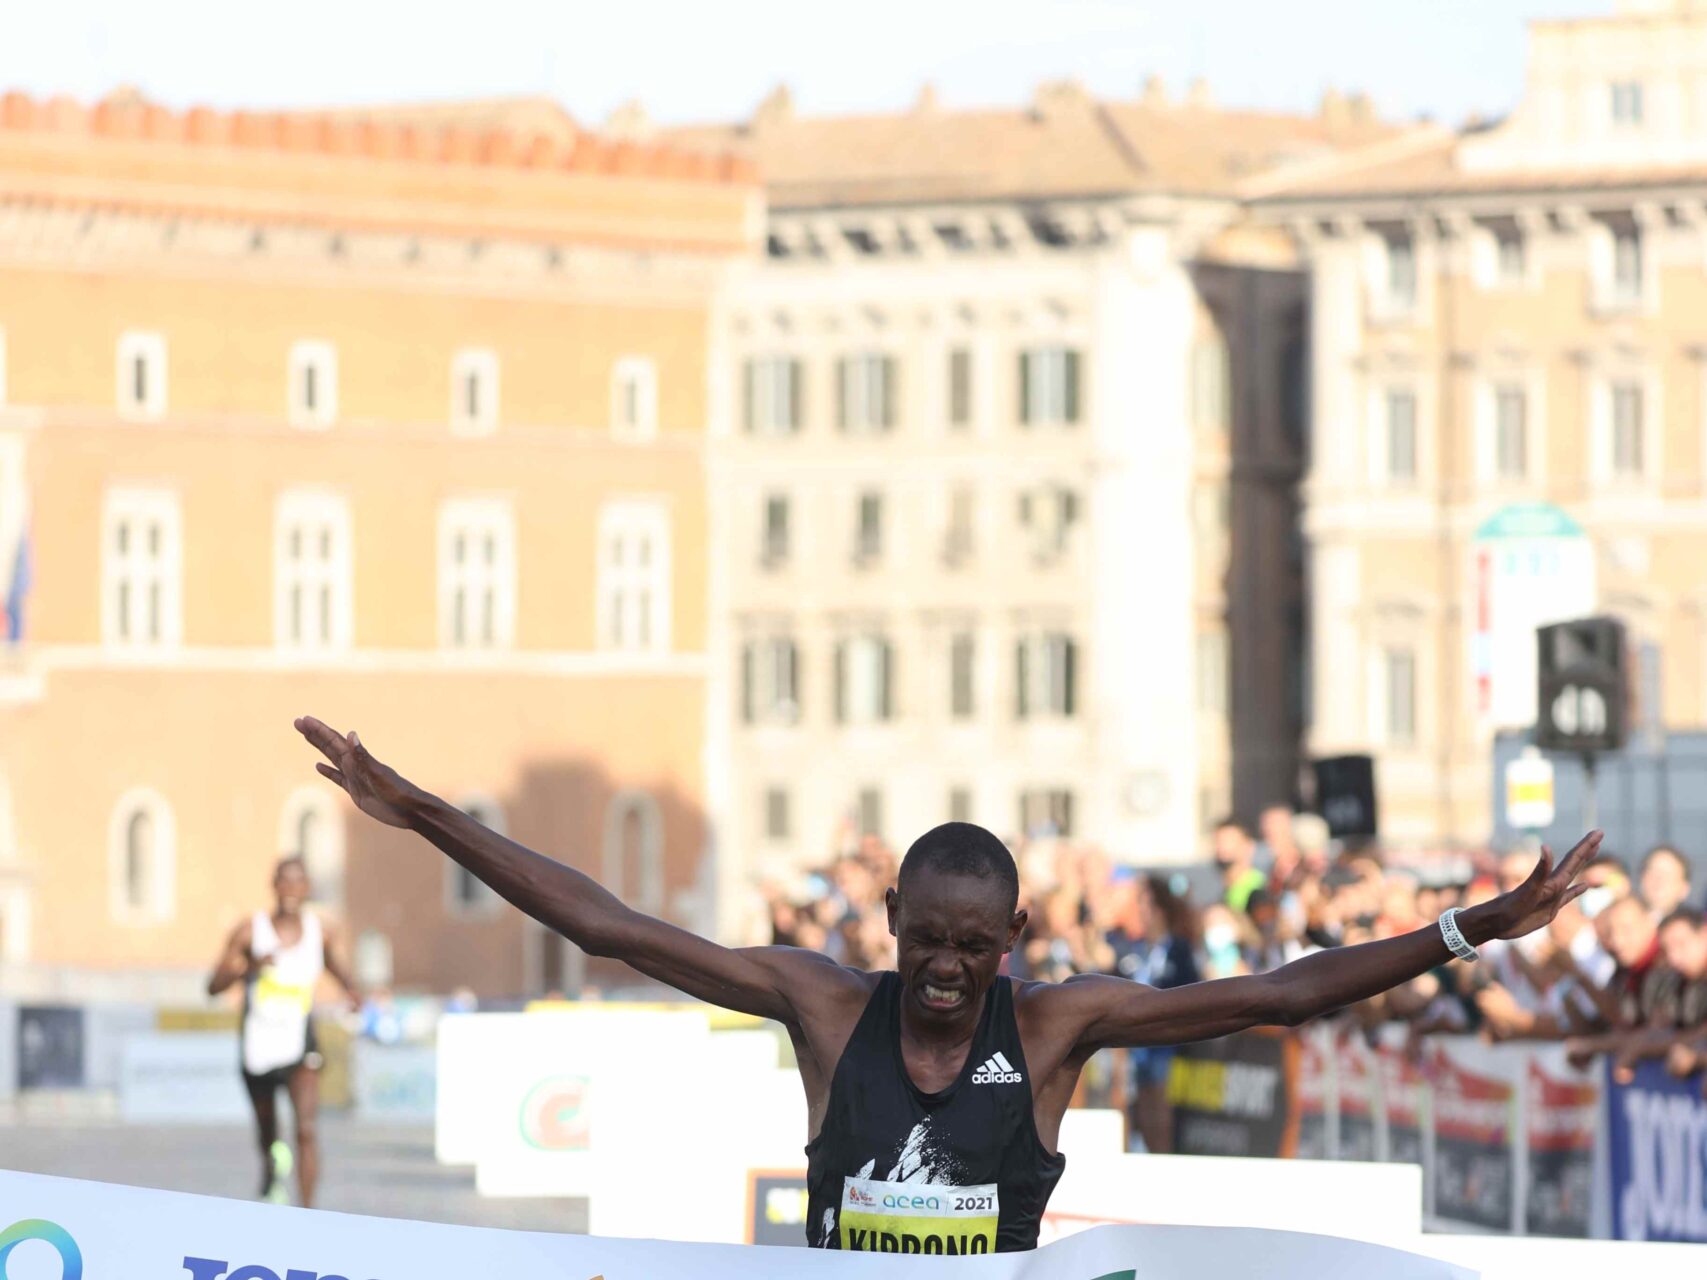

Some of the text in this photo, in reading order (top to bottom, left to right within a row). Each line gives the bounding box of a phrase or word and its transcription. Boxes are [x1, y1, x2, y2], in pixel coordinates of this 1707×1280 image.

[972, 1071, 1022, 1084] adidas
[883, 1194, 939, 1210] acea
[954, 1197, 993, 1211] 2021
